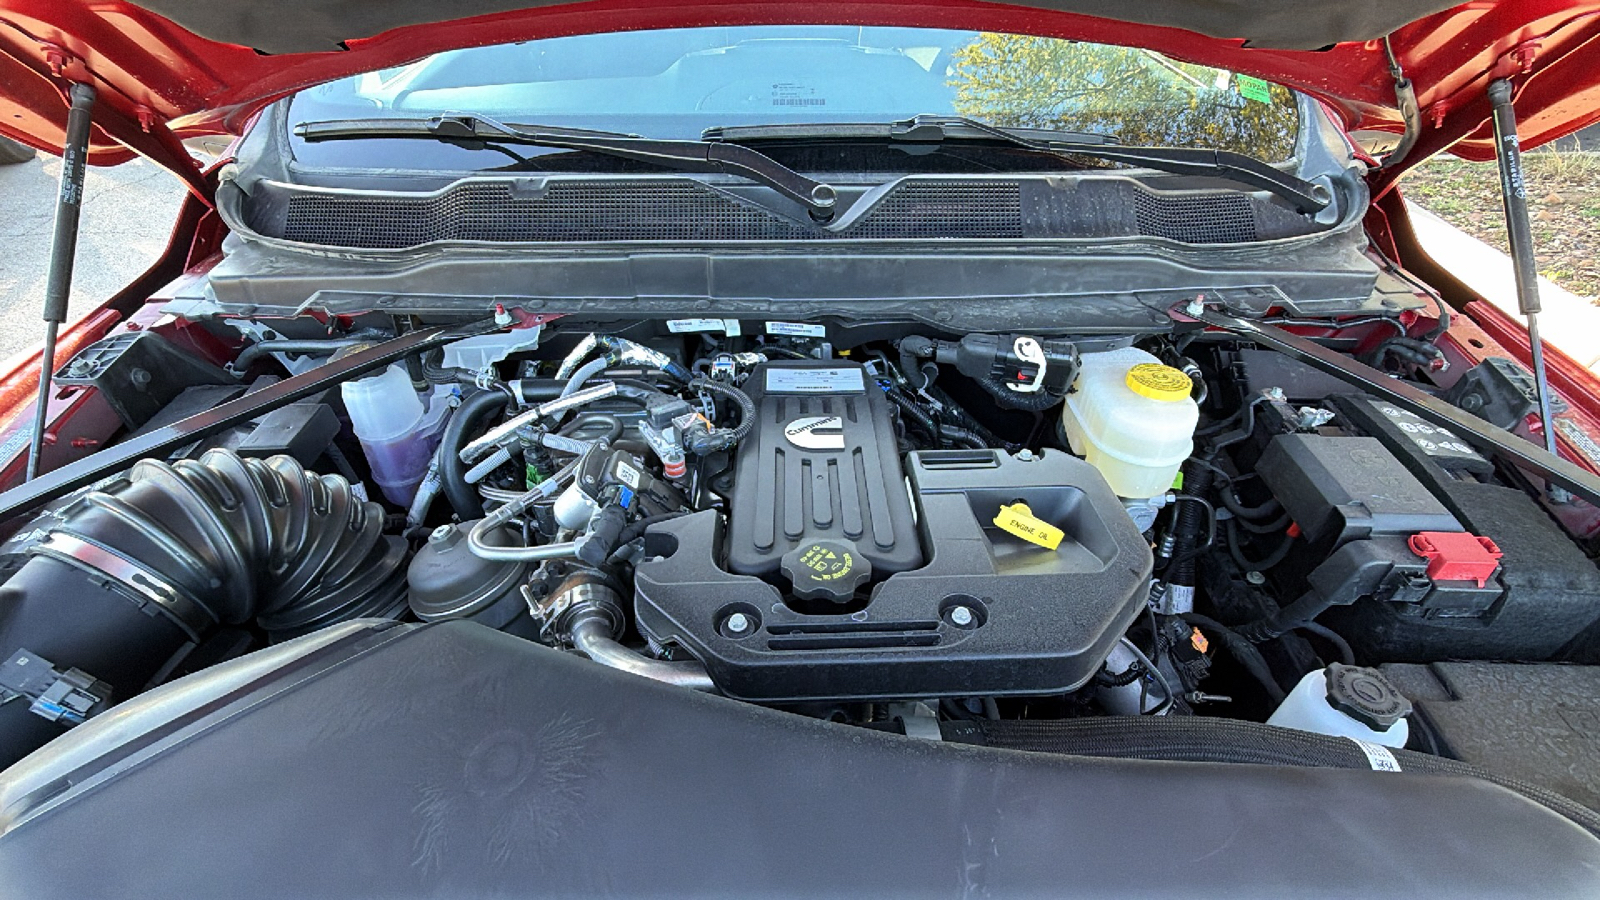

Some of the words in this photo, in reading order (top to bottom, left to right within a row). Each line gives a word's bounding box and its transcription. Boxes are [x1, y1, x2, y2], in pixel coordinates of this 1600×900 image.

[786, 416, 838, 436] Cummins
[1009, 519, 1036, 536] ENGINE
[1037, 531, 1049, 541] OIL
